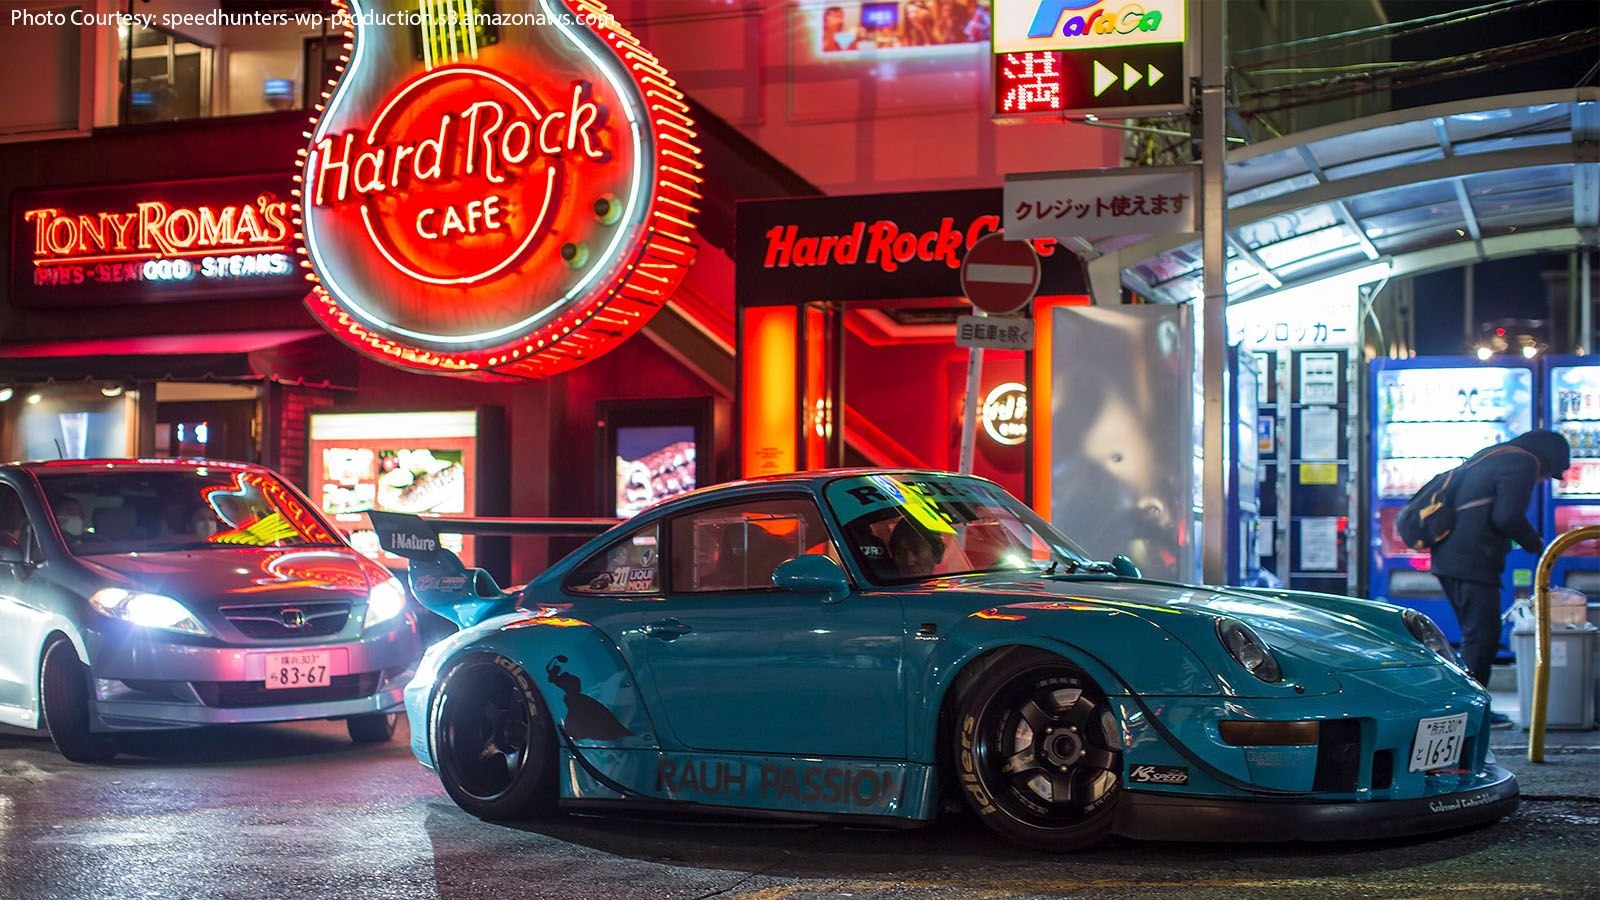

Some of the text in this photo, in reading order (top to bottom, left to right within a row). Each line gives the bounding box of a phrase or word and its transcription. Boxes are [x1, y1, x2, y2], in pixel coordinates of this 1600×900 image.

[1004, 52, 1059, 111] 満
[315, 85, 603, 207] Hard Rock
[416, 195, 501, 239] CAFE
[1015, 192, 1190, 221] クレジット使えます
[24, 207, 138, 256] TONY
[763, 215, 1057, 272] Hard Rock Ce
[961, 322, 1029, 343] 自転車を除く
[280, 665, 327, 685] 83-67
[655, 759, 904, 807] RAUH PASSION
